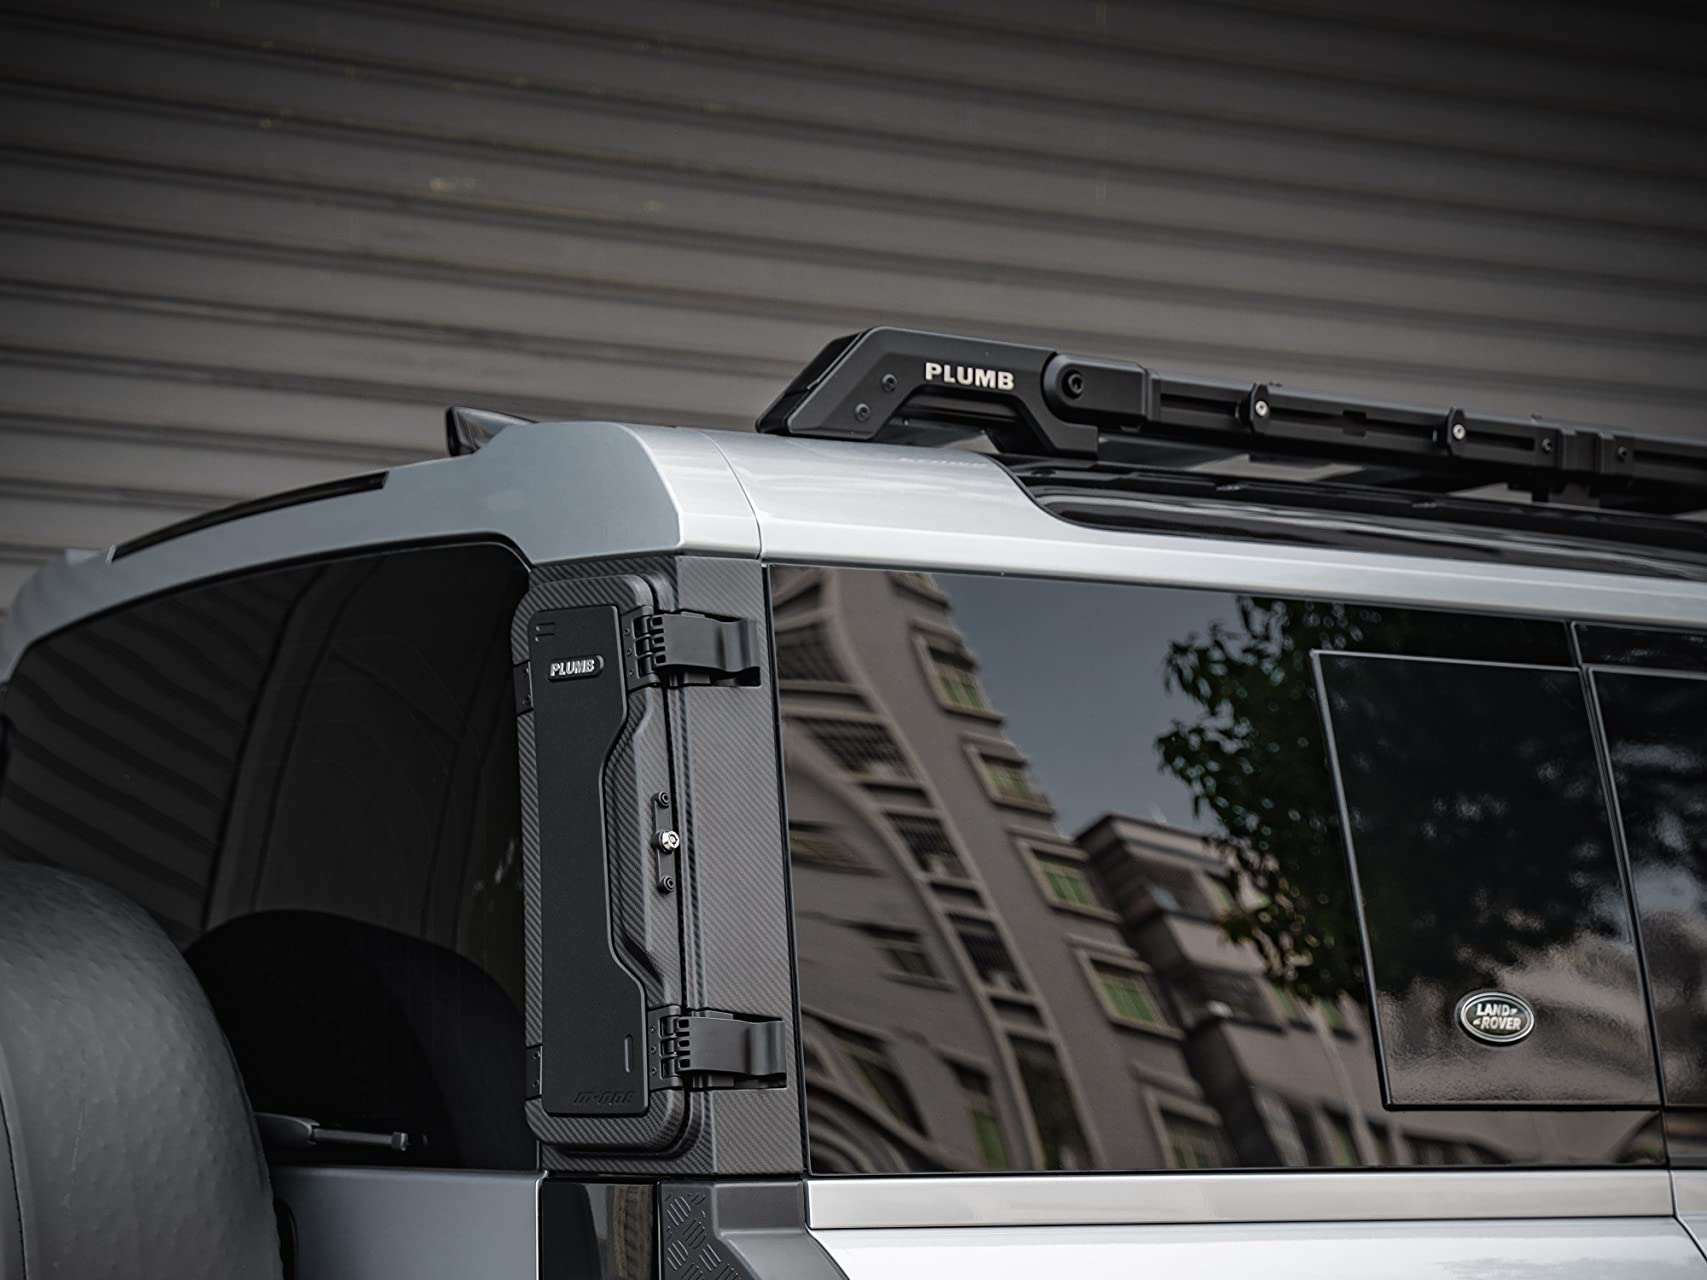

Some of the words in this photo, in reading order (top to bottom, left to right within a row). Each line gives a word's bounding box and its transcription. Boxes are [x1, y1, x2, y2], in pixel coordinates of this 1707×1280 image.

[925, 361, 1015, 391] PLUMB
[549, 658, 595, 678] PLUMB
[1476, 1003, 1511, 1016] LAND
[1480, 1016, 1522, 1030] ROVER
